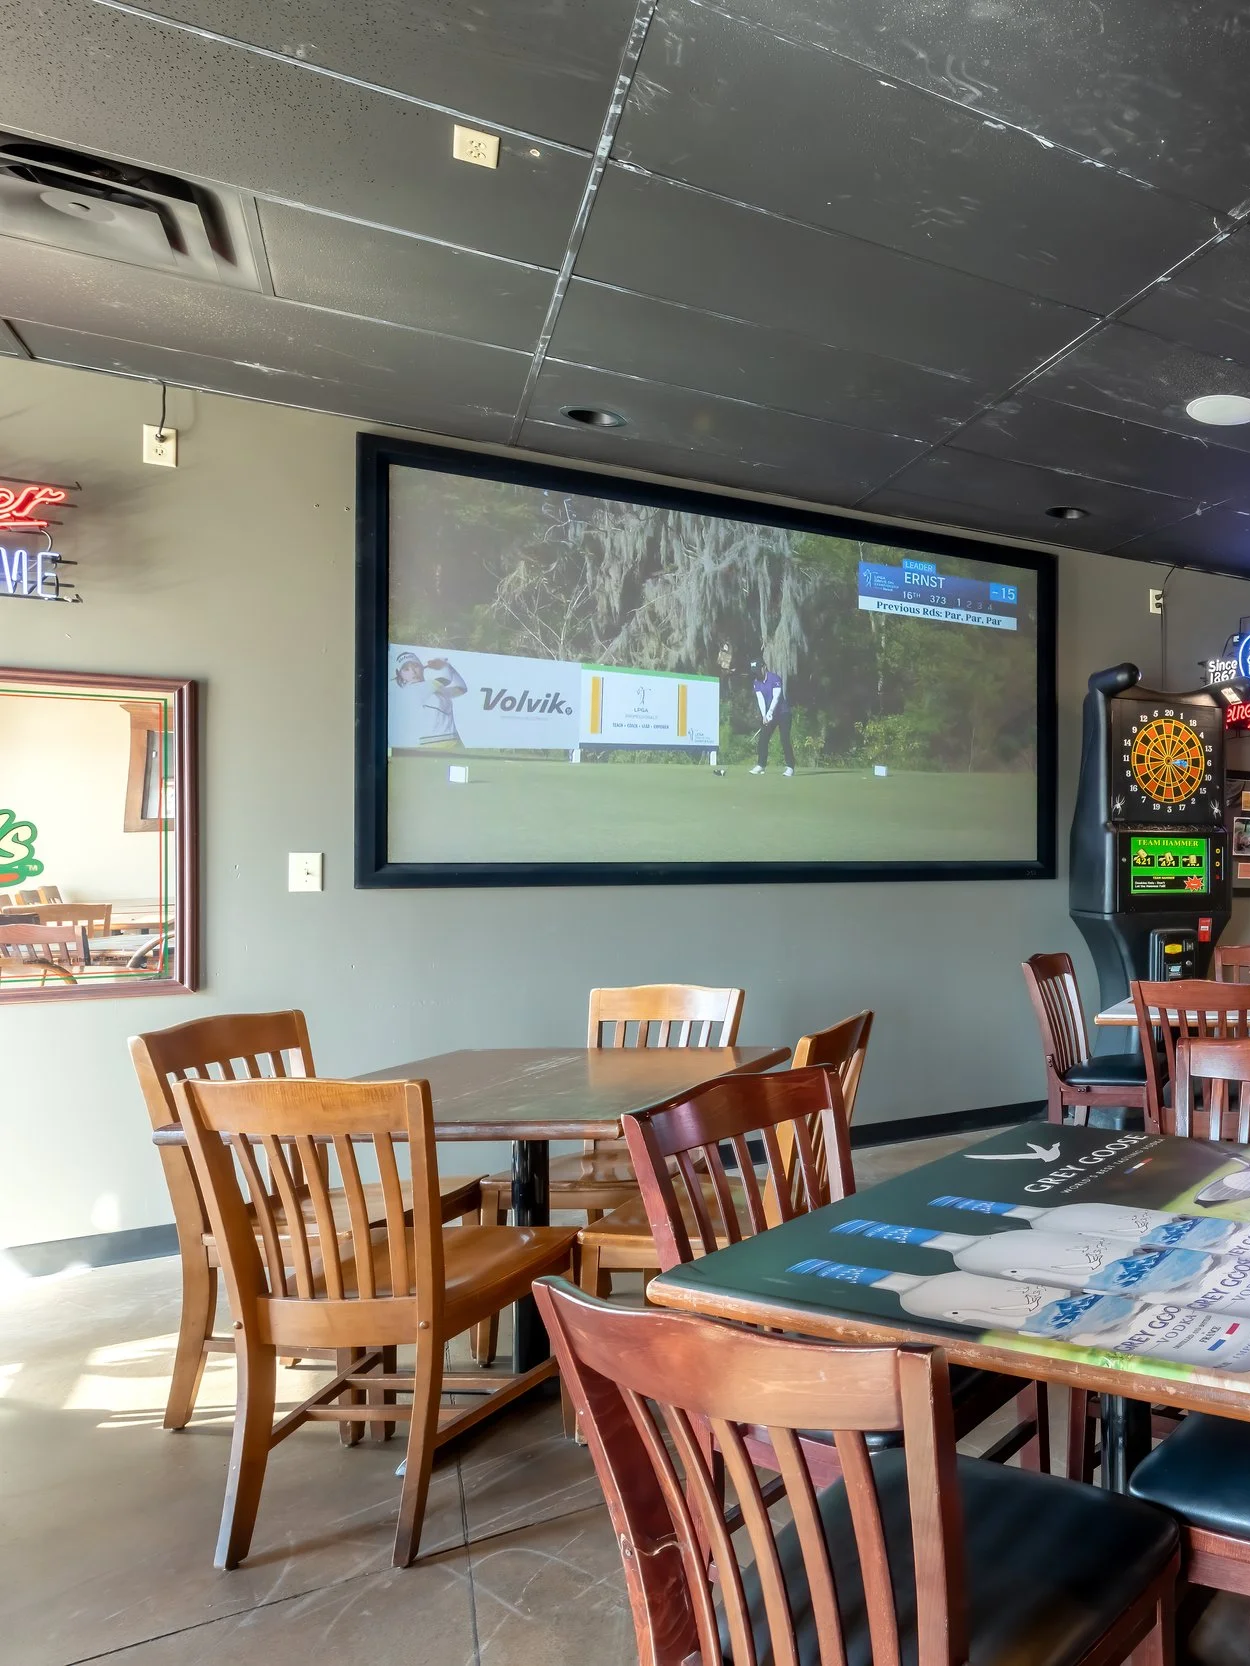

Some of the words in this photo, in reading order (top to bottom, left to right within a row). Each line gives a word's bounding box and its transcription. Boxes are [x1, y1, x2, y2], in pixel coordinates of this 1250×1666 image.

[904, 561, 934, 572] LEADER
[904, 571, 946, 589] ERNST
[902, 590, 921, 600] 16TH
[929, 594, 947, 605] 373
[876, 600, 921, 615] Previous
[922, 606, 943, 618] Rds:
[944, 610, 964, 622] Par,
[965, 613, 984, 625] Par,
[985, 615, 1002, 626] Par
[1208, 659, 1238, 672] Since
[1210, 670, 1236, 684] 1867
[480, 687, 567, 715] Volvik
[1136, 857, 1151, 865] 421
[1024, 1164, 1086, 1193] GREY
[1078, 1134, 1149, 1164] GOOSE
[1060, 1174, 1099, 1194] WORLD'S
[1096, 1165, 1116, 1175] BEST
[1113, 1149, 1144, 1165] TASTING
[1141, 1138, 1166, 1150] VODKA
[1186, 1287, 1230, 1310] GREY
[1113, 1330, 1156, 1352] GREY
[1148, 1305, 1181, 1329] GOO
[1156, 1313, 1197, 1344] VODKA
[1199, 1325, 1222, 1344] FRANCE
